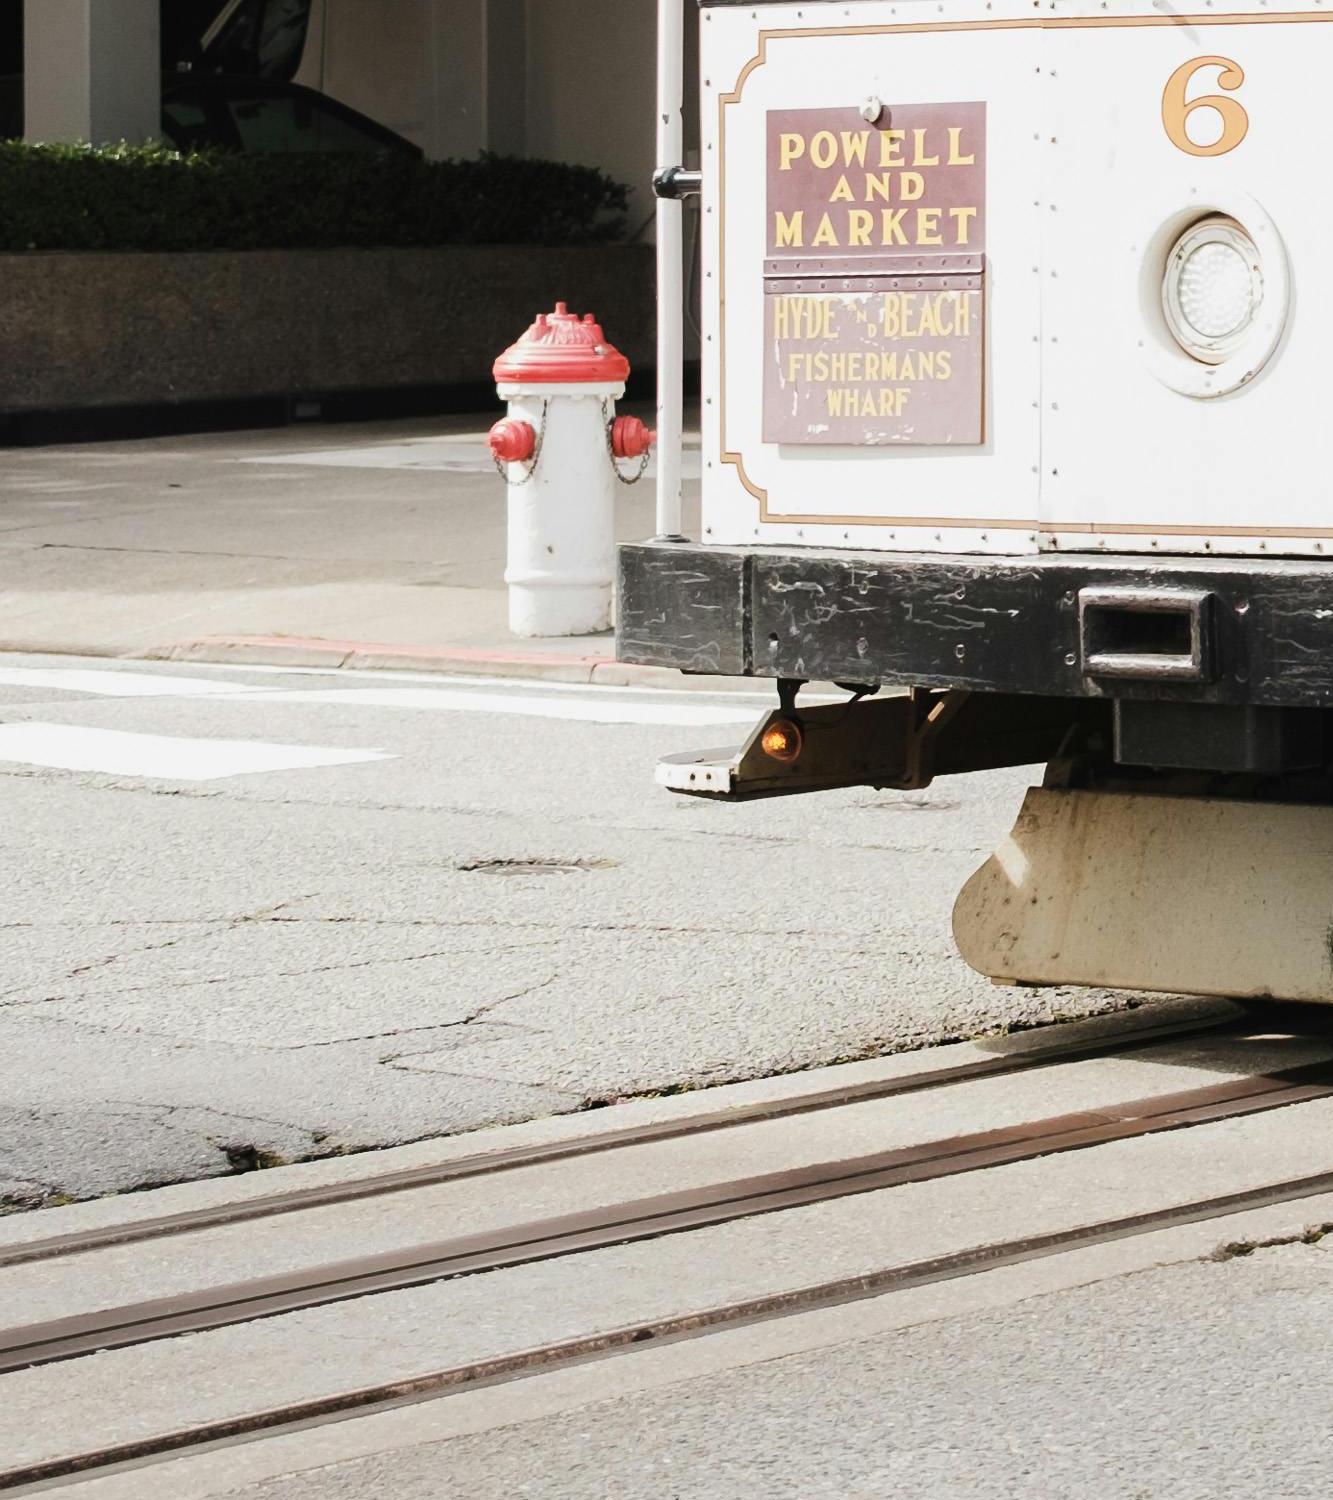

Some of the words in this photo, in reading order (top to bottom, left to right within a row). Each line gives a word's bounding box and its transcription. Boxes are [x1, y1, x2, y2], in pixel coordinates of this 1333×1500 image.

[1161, 55, 1249, 157] 6
[779, 128, 975, 171] POWELL
[830, 173, 926, 203] AND
[775, 206, 977, 248] MARKET
[774, 295, 838, 340] HYDE
[883, 294, 971, 338] BEACH
[789, 351, 952, 382] FISHERMANS
[827, 388, 912, 418] WHARF
